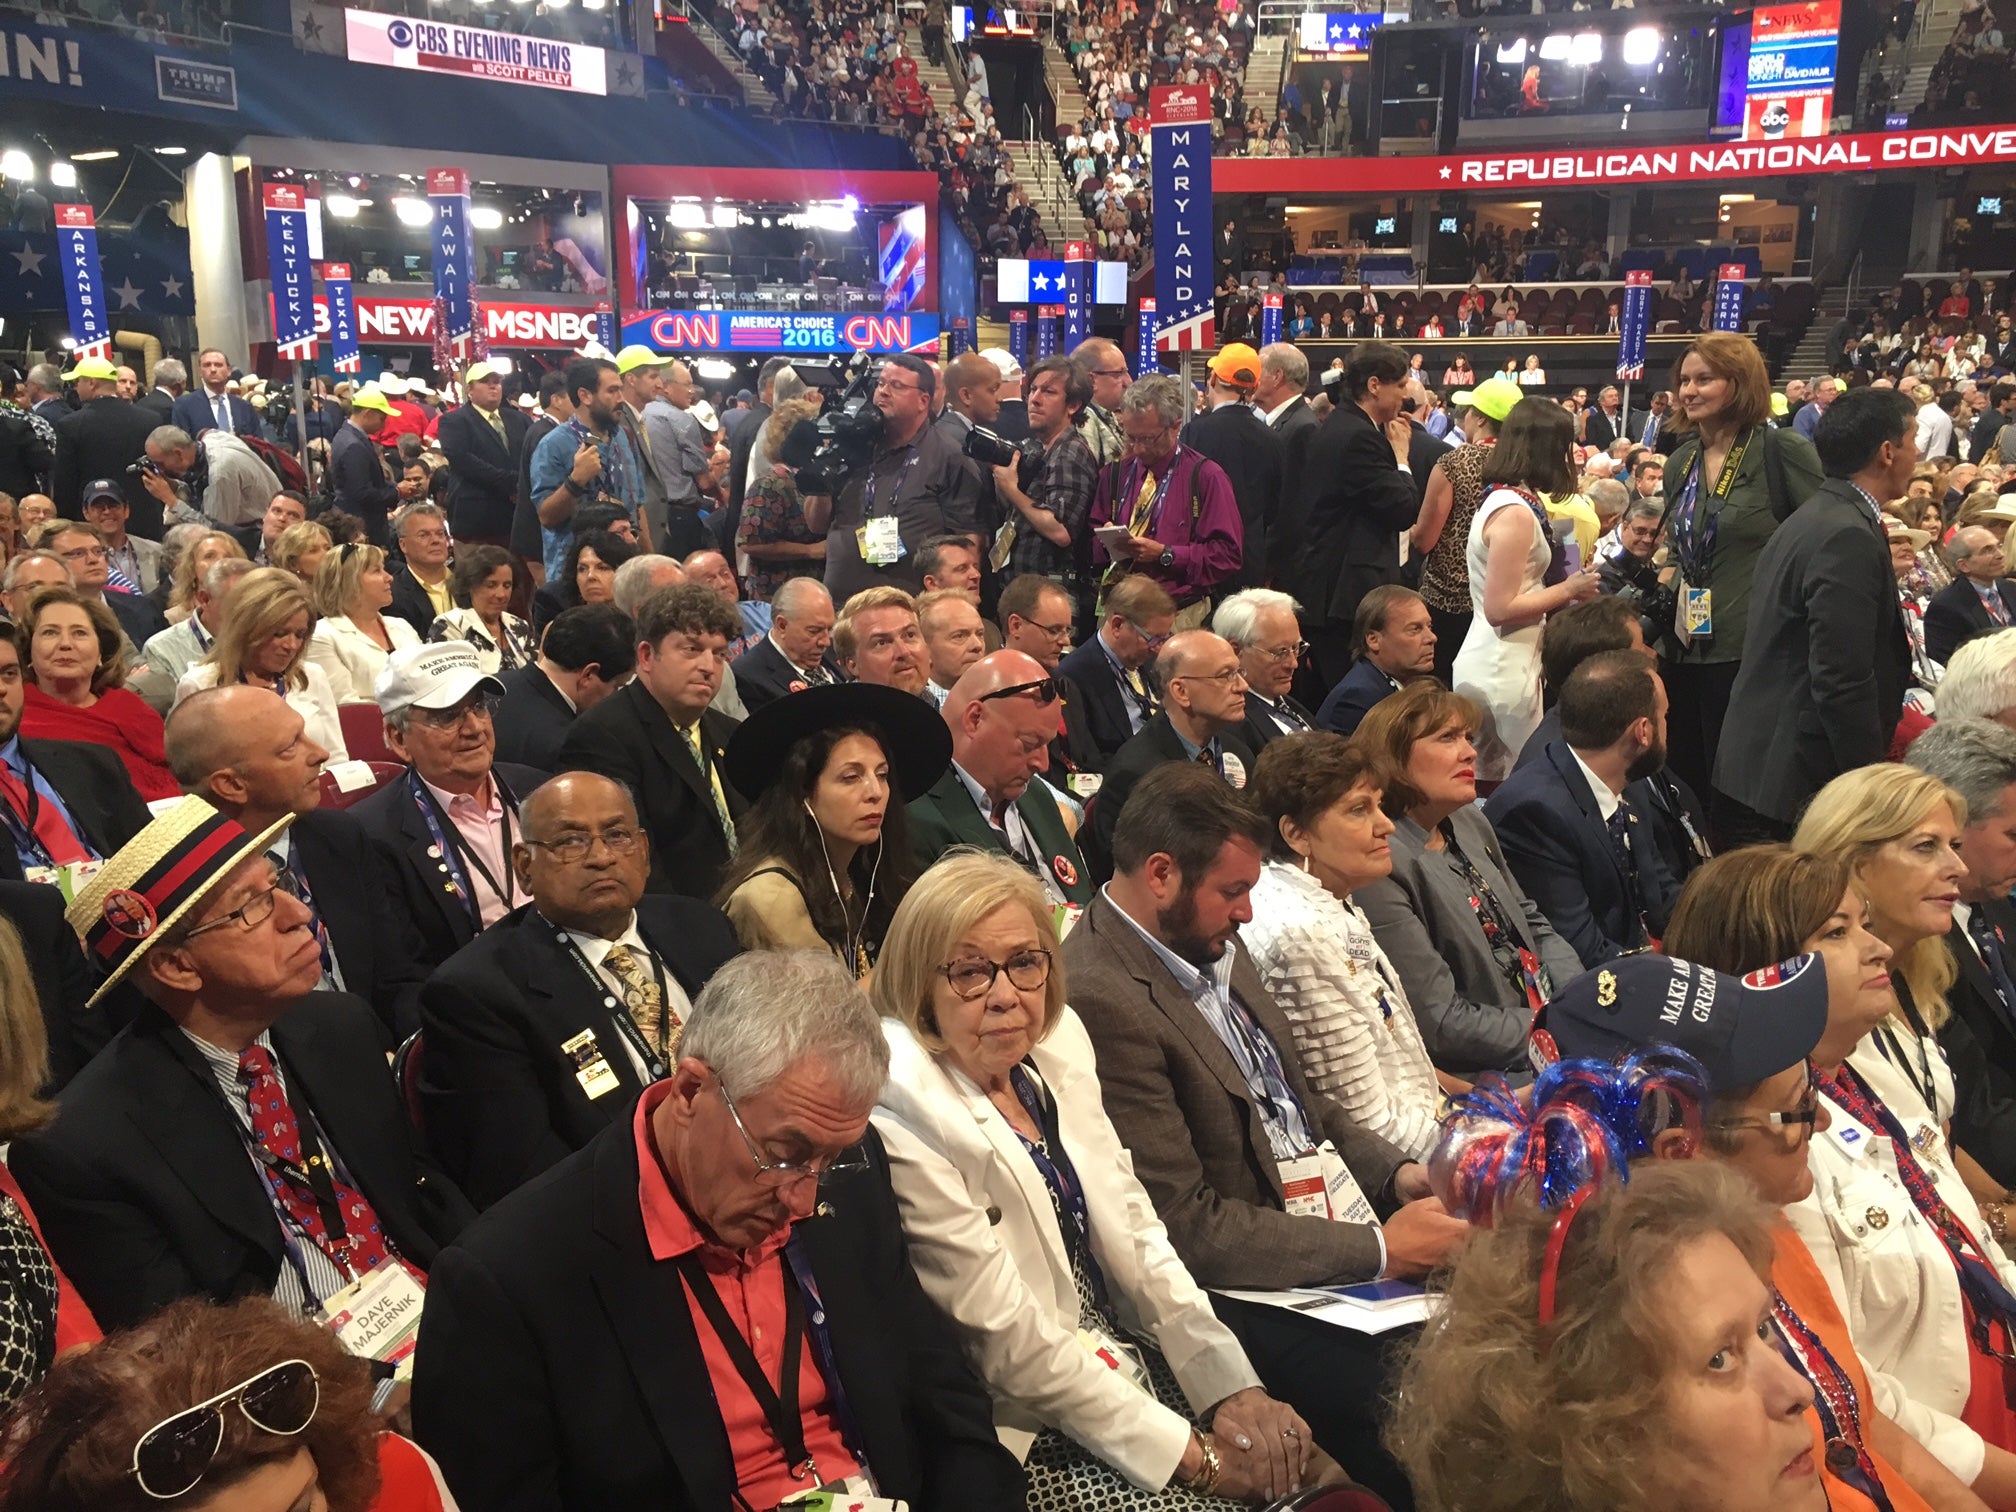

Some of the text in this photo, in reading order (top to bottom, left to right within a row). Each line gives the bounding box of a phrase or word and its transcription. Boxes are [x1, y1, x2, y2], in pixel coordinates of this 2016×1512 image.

[1772, 12, 1812, 26] NEWS
[415, 24, 572, 72] CBS EVENING NEWS
[169, 68, 227, 85] TRUMP
[174, 79, 222, 94] PENCE
[486, 64, 526, 79] SCOTT
[528, 71, 571, 85] PELLEY
[1784, 67, 1830, 79] DAVID MUIR
[1760, 112, 1790, 127] abc
[1461, 130, 2016, 182] REPUBLICAN NATIONAL CONVE
[1171, 130, 1193, 301] MARYLAND
[281, 215, 302, 326] KENTUCKY
[440, 205, 457, 314] HAWAII
[72, 230, 96, 331] ARKANSAS
[334, 286, 349, 340] TEXAS
[358, 304, 436, 335] NEW
[1069, 278, 1077, 334] IOWA
[1141, 314, 1148, 326] US
[1719, 283, 1729, 328] AMERI
[1729, 293, 1740, 329] SAMO
[488, 309, 599, 341] MSNBC
[601, 313, 610, 349] COLOR
[651, 314, 720, 348] CNN
[730, 316, 835, 329] AMERICA'S CHOICE
[783, 329, 836, 347] 2016
[844, 316, 911, 349] CNN
[1633, 288, 1646, 359] NORTH DAKOTA
[1716, 468, 1733, 496] Nikon
[419, 657, 446, 671] MAKE
[431, 661, 480, 676] GREAT AGAIN
[569, 947, 604, 991] themavericks.com
[1349, 948, 1370, 957] DEAD
[1660, 977, 1689, 1026] MAKE
[1691, 972, 1717, 1023] GREAT
[616, 1012, 652, 1058] themavericks.com
[1342, 1194, 1364, 1218] TUESDAY
[1349, 1201, 1367, 1222] JULY 19
[1358, 1208, 1371, 1222] 2016
[352, 1293, 416, 1351] MAJERNIK
[356, 1295, 394, 1329] DAVE
